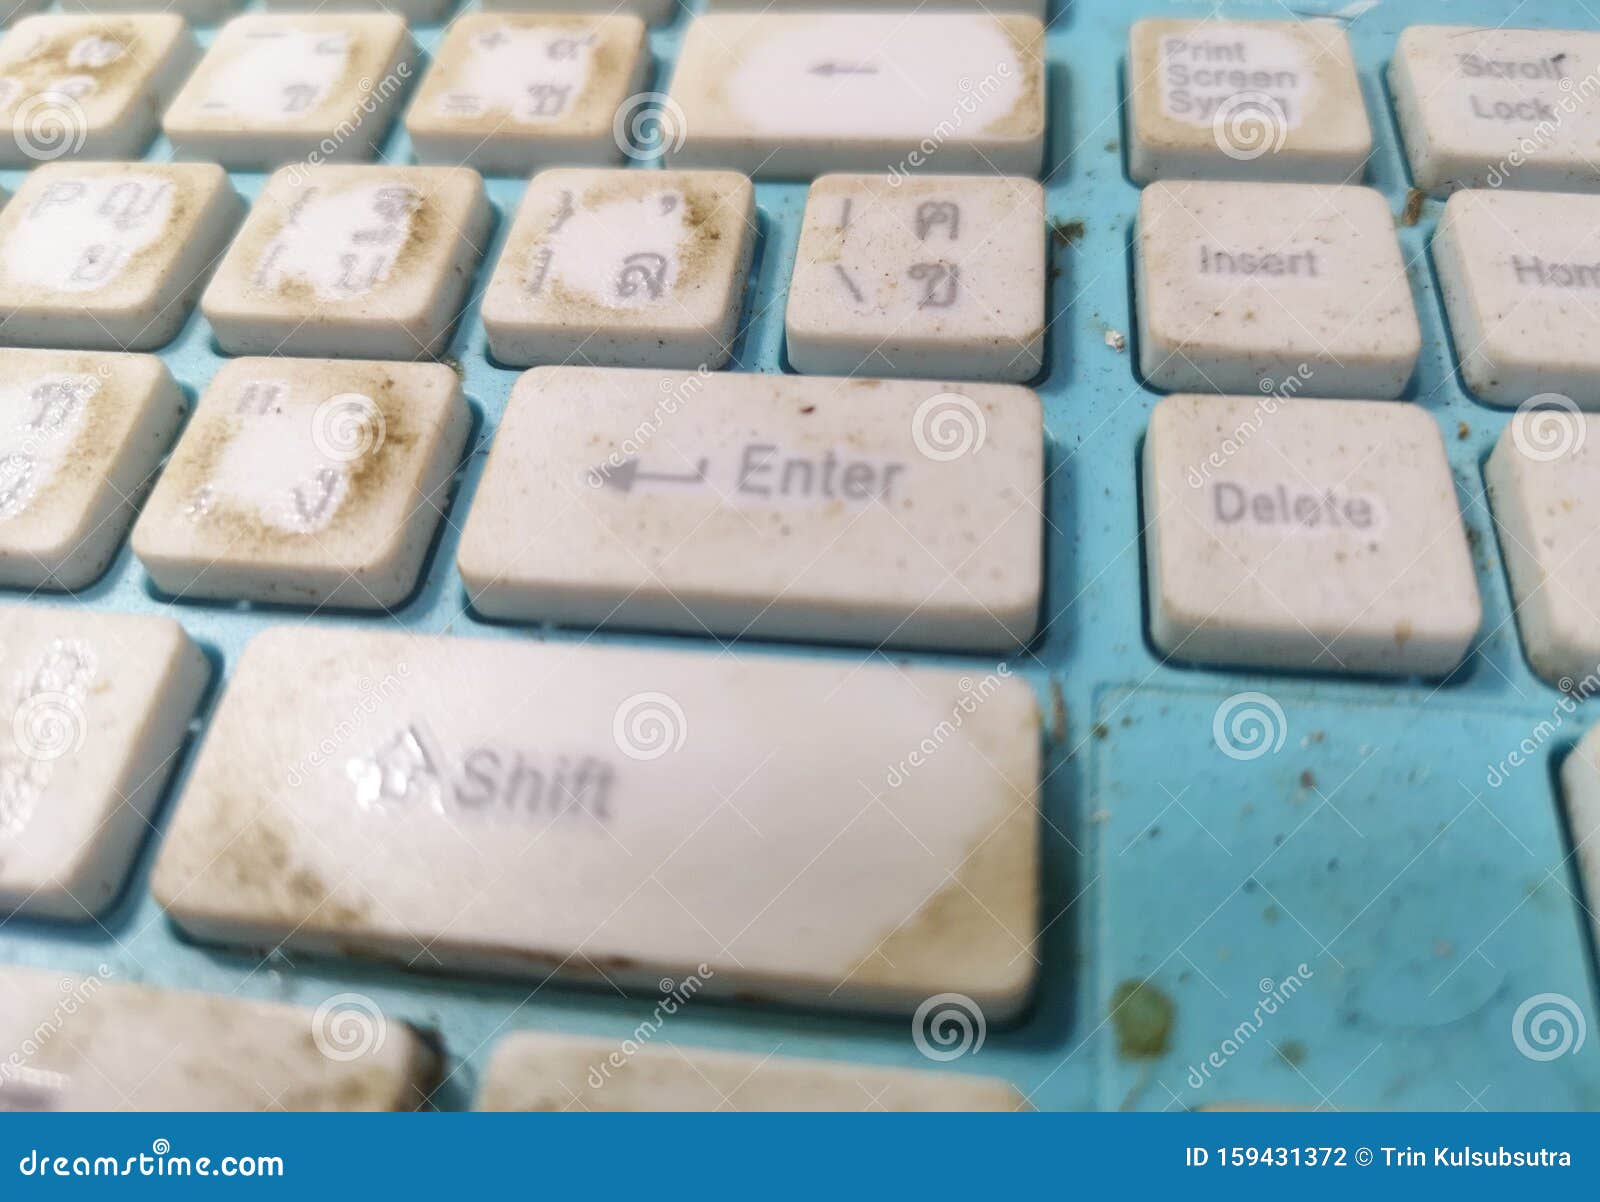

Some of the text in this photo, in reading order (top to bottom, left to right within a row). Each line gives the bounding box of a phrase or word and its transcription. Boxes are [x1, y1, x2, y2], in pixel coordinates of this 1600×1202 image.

[1165, 39, 1246, 63] Print
[1167, 64, 1297, 88] Screen
[1460, 53, 1564, 79] Scroll
[1470, 93, 1559, 122] Lock
[1200, 247, 1319, 277] Insert
[736, 445, 905, 502] Enter
[1213, 484, 1373, 528] Delete
[453, 748, 615, 820] Shift
